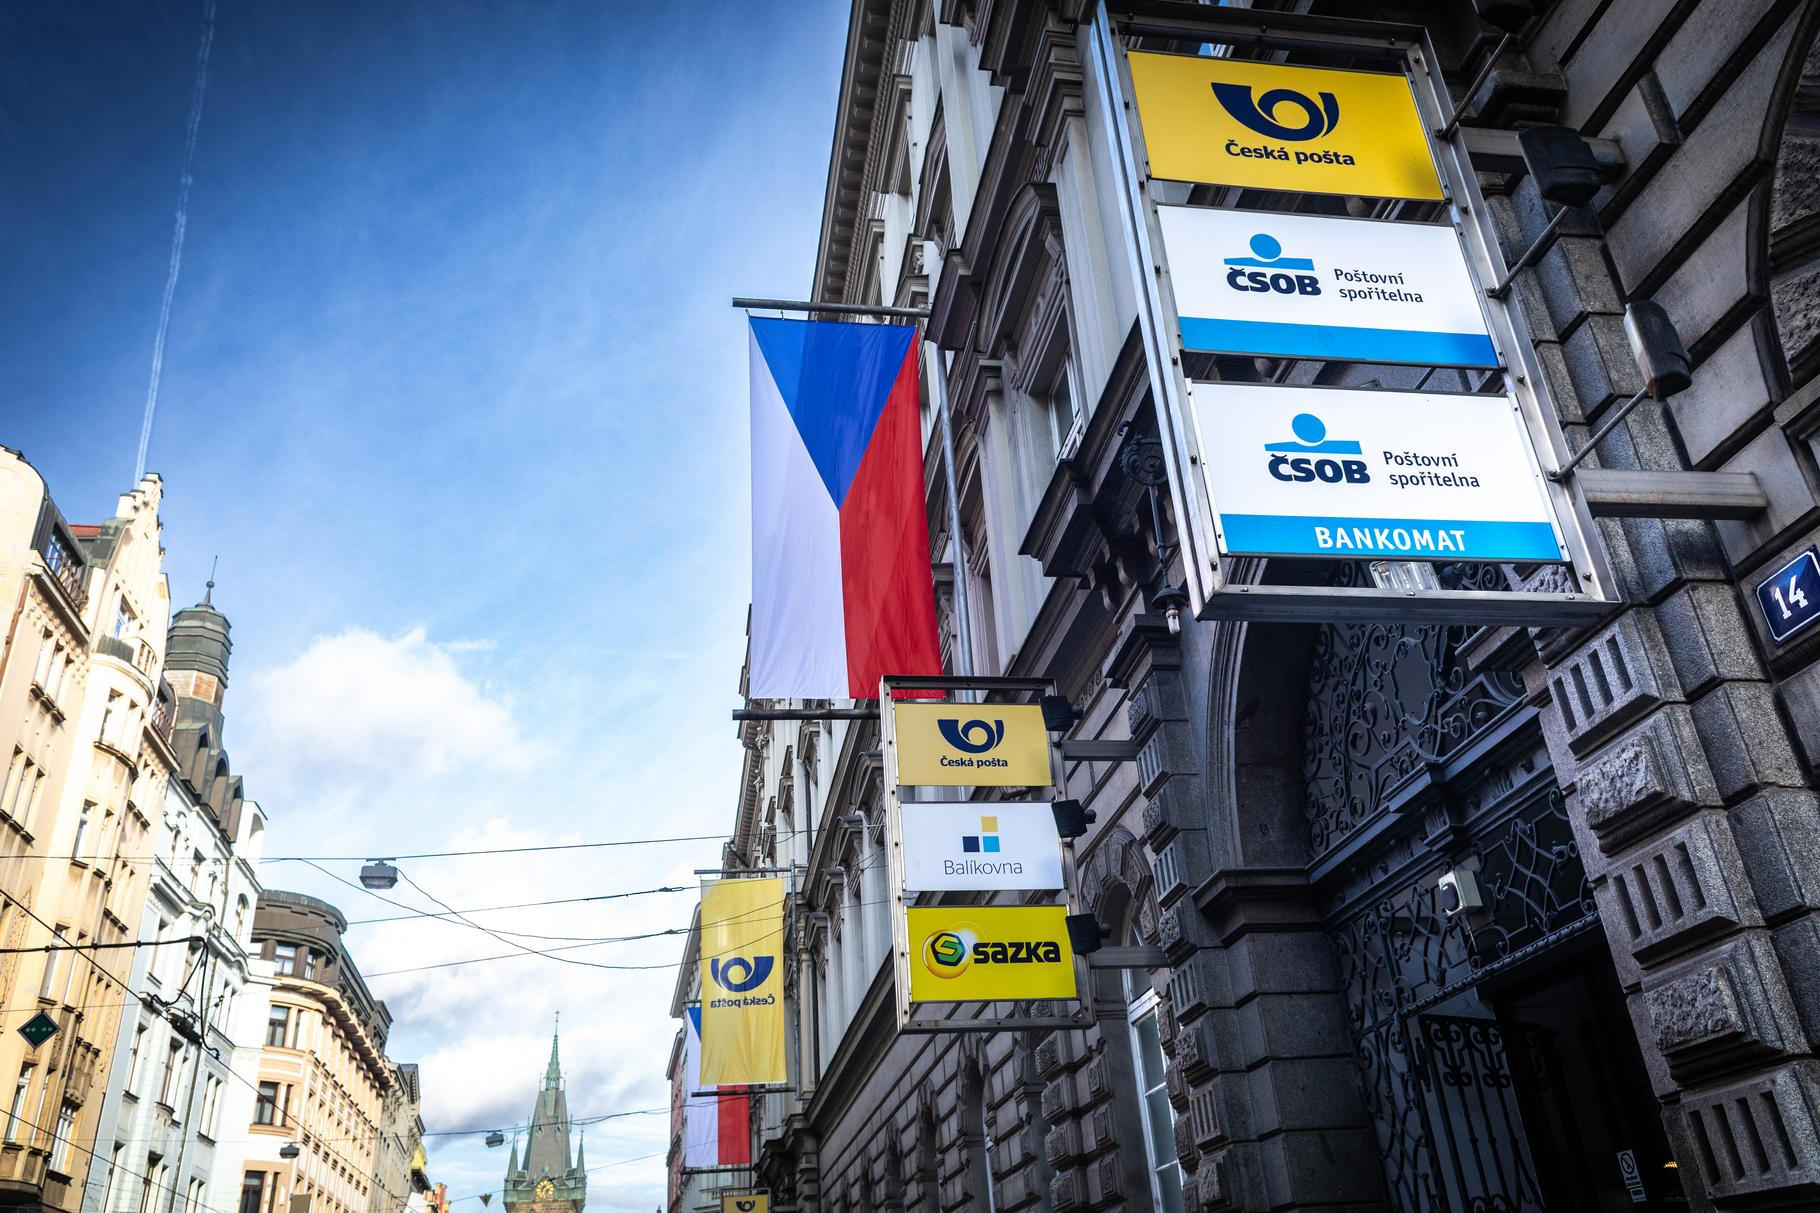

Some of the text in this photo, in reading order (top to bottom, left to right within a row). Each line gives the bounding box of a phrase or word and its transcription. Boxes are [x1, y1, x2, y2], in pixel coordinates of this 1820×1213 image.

[1225, 139, 1356, 166] Česká pošta
[1226, 267, 1322, 296] ČSOB
[1334, 268, 1404, 285] Poštovní
[1339, 287, 1424, 303] spořitelna
[1383, 450, 1459, 468] Poštovní
[1268, 454, 1371, 484] ČSOB
[1389, 471, 1480, 489] spořitelna
[1314, 526, 1466, 552] BANKOMAT
[1771, 574, 1809, 620] 14
[940, 755, 1009, 769] Česká pošta
[943, 859, 1023, 875] Balíkovna
